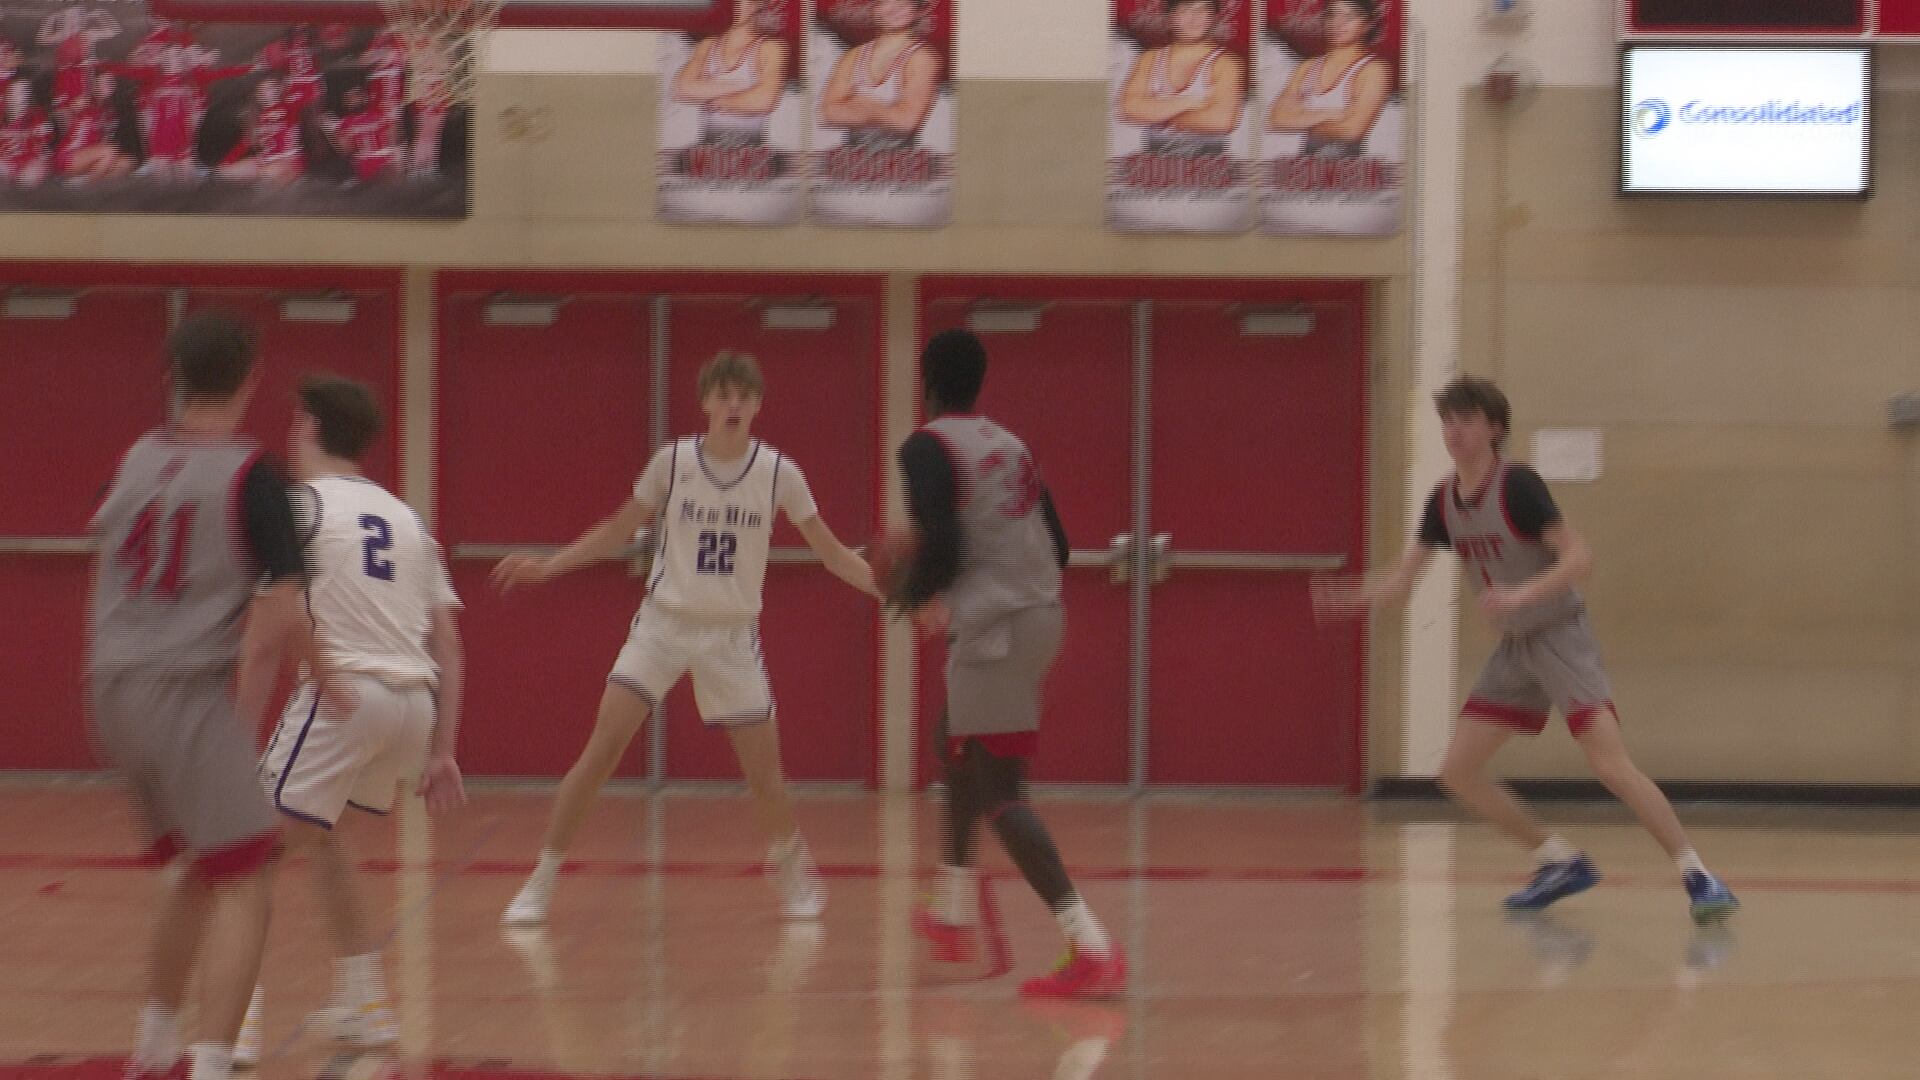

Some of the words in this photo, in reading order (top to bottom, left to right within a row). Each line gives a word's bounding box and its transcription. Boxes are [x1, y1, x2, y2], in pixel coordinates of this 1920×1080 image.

[1679, 99, 1860, 125] Consolidated
[115, 495, 199, 600] 41
[356, 513, 397, 582] 2
[696, 530, 737, 576] 22
